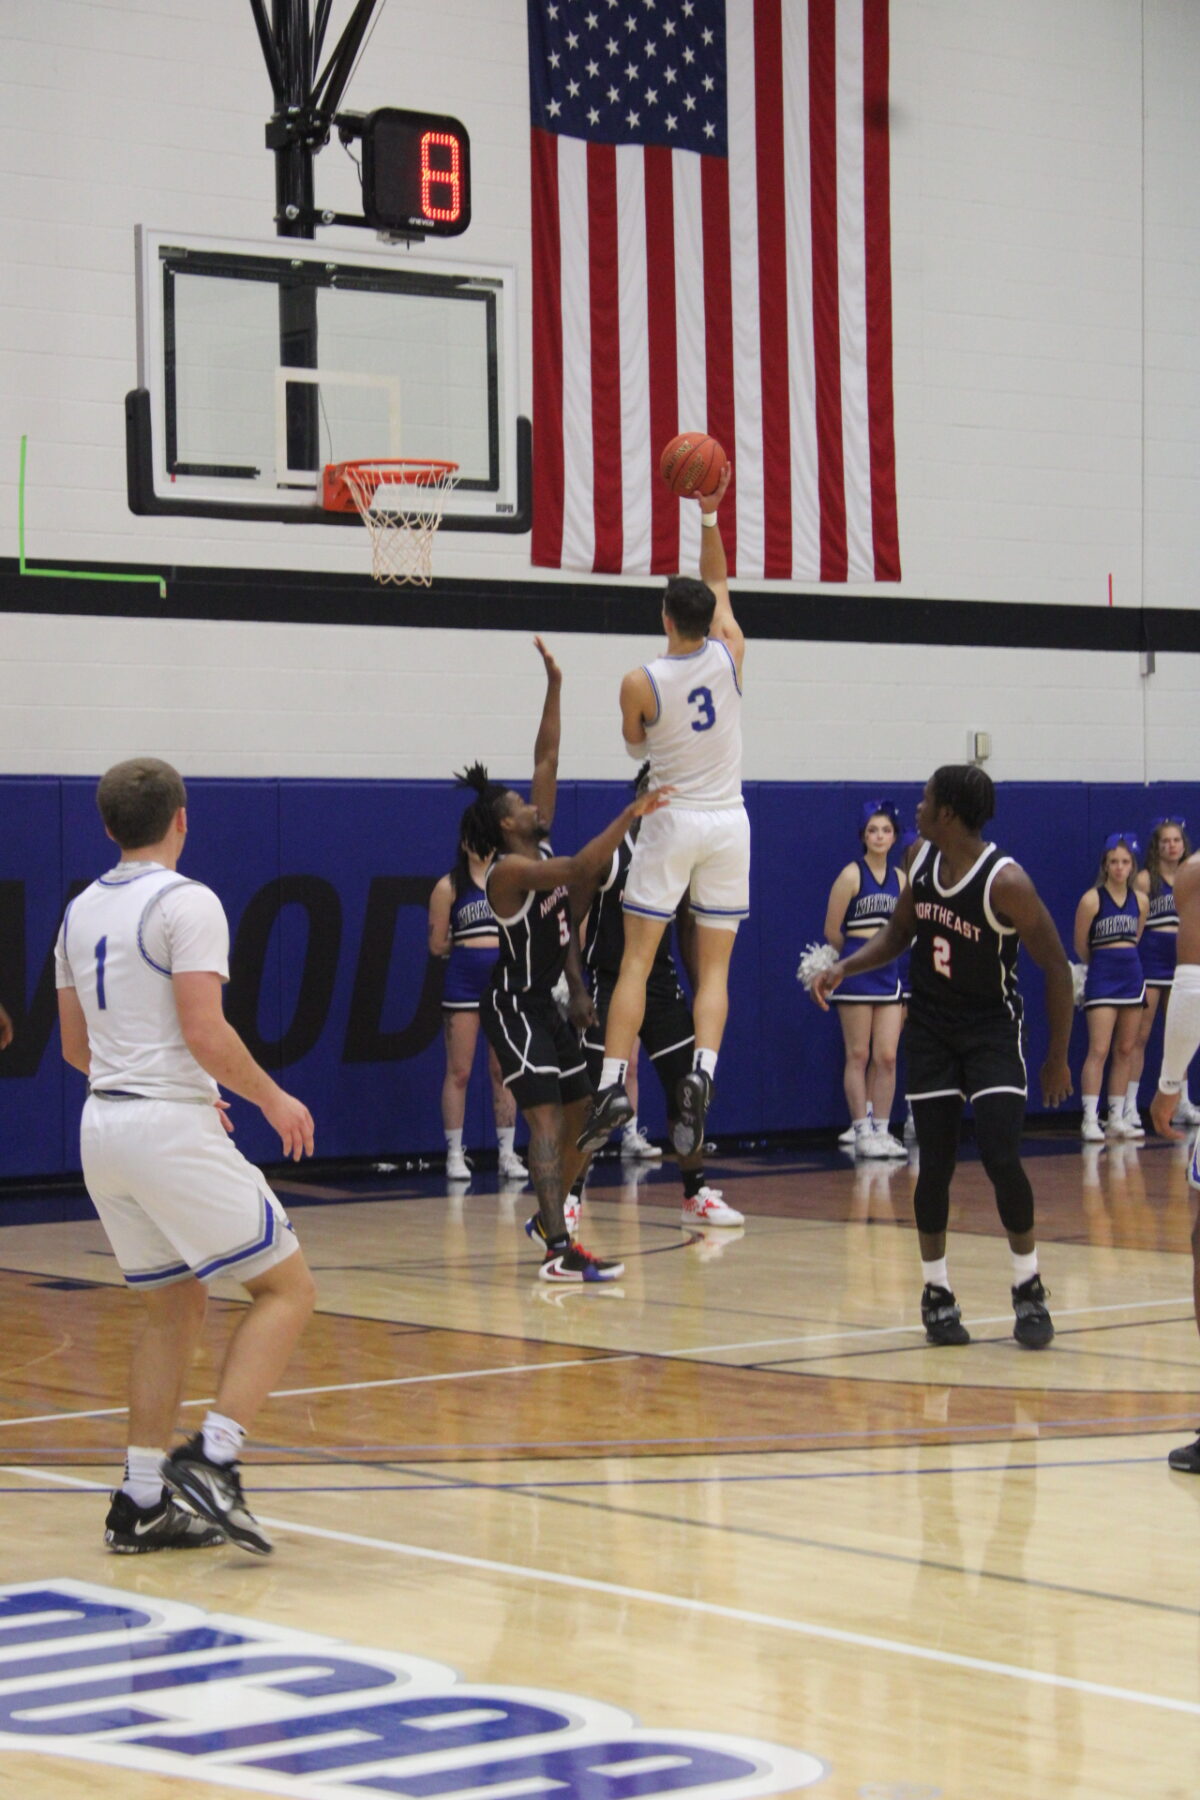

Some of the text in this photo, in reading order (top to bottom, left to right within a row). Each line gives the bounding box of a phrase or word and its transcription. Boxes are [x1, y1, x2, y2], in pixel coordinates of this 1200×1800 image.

[421, 132, 460, 222] 8
[687, 685, 716, 732] 3
[557, 907, 571, 946] 5
[94, 933, 107, 1011] 1
[932, 934, 953, 980] 2
